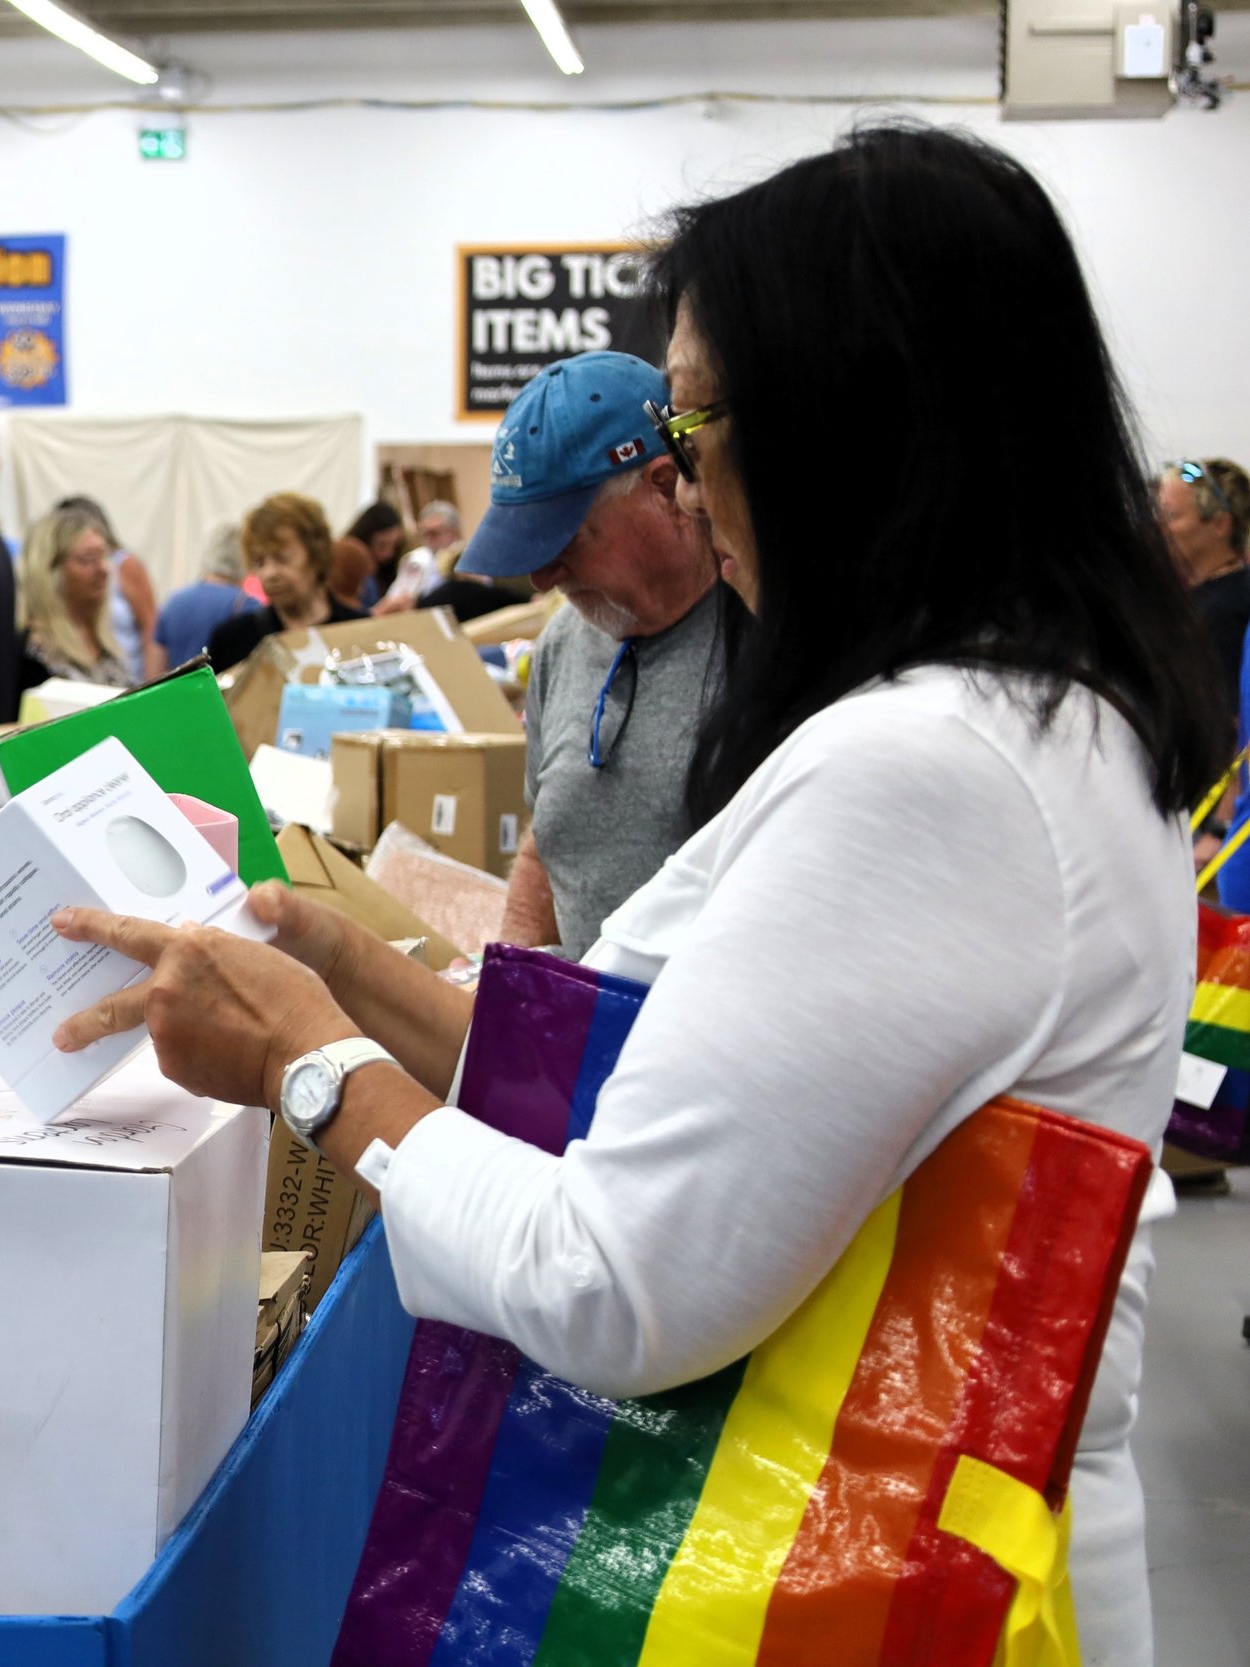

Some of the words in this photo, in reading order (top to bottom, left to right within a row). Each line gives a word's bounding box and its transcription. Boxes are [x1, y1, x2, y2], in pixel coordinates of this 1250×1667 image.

[472, 254, 556, 300] BIG
[561, 254, 643, 299] TIC
[471, 306, 612, 353] ITEMS
